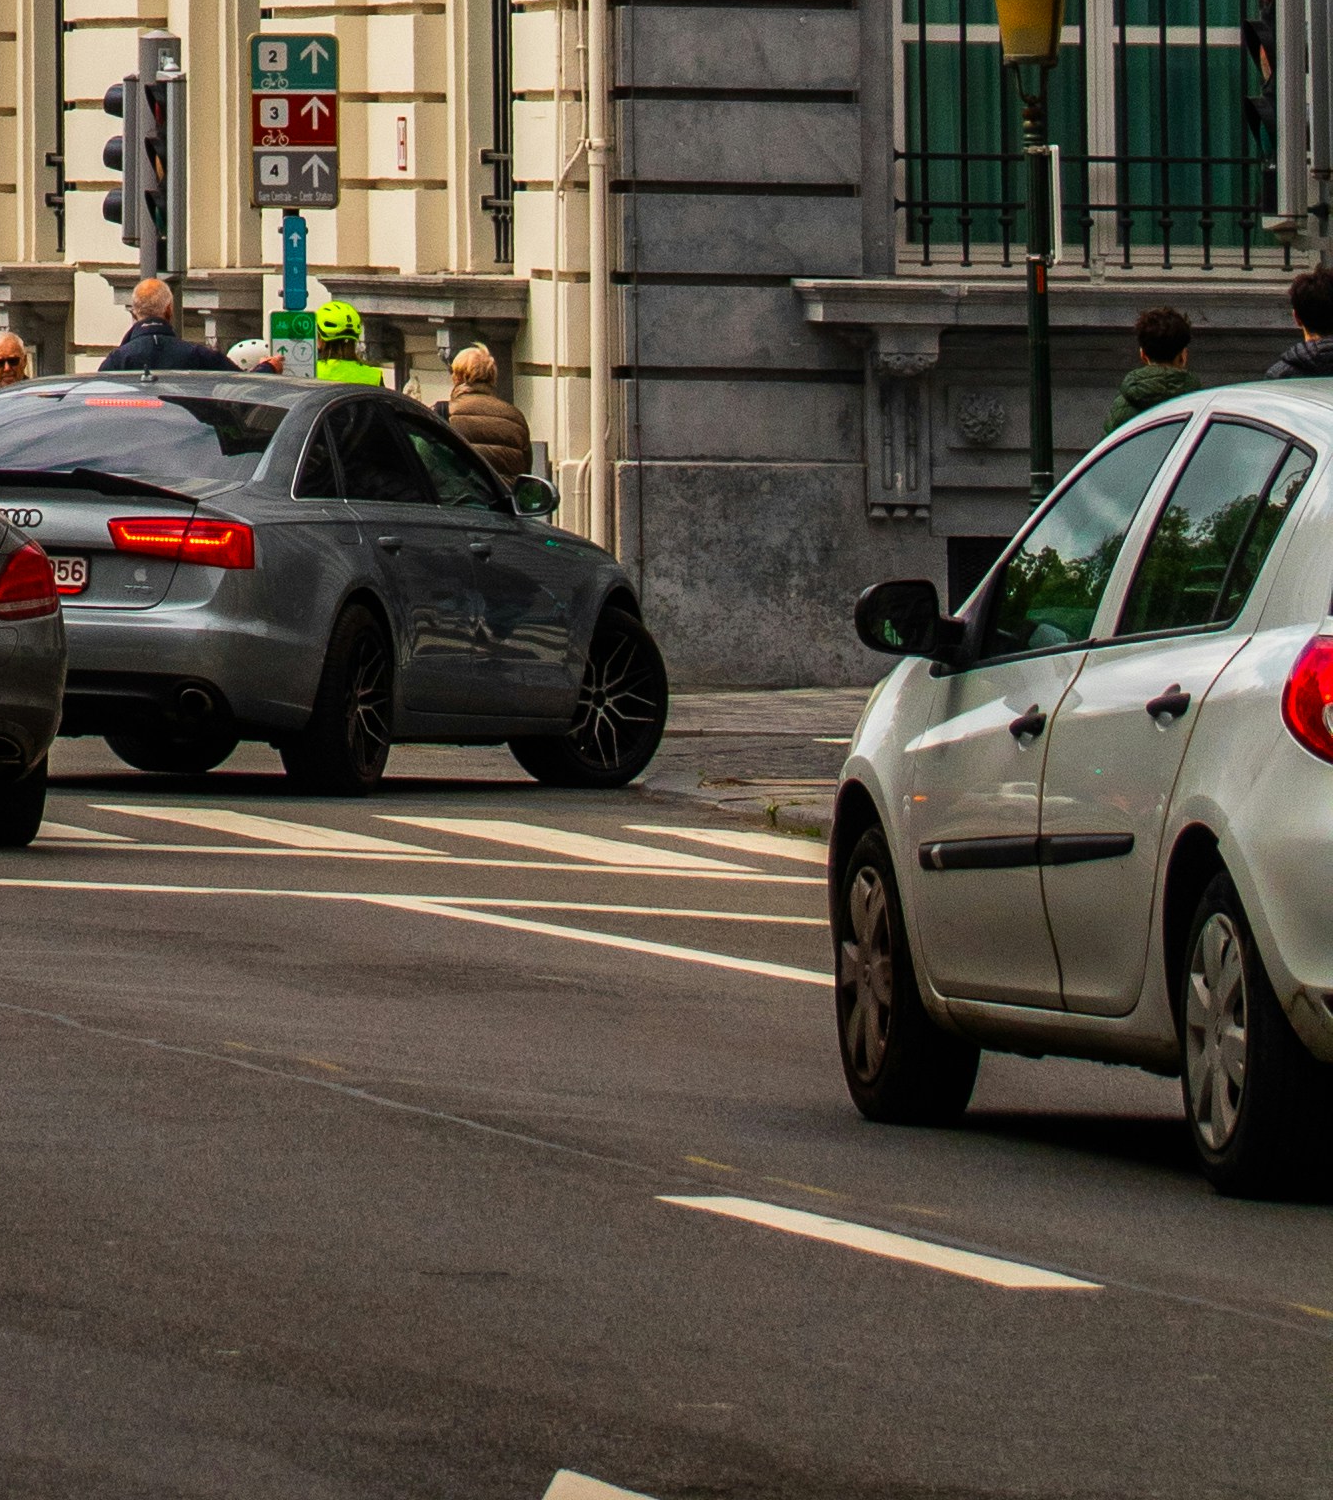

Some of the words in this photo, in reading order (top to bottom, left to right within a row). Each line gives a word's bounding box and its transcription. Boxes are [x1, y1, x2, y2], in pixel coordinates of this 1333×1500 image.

[268, 50, 277, 63] 2
[270, 106, 279, 120] 3
[270, 164, 279, 177] 4
[299, 346, 306, 357] 7
